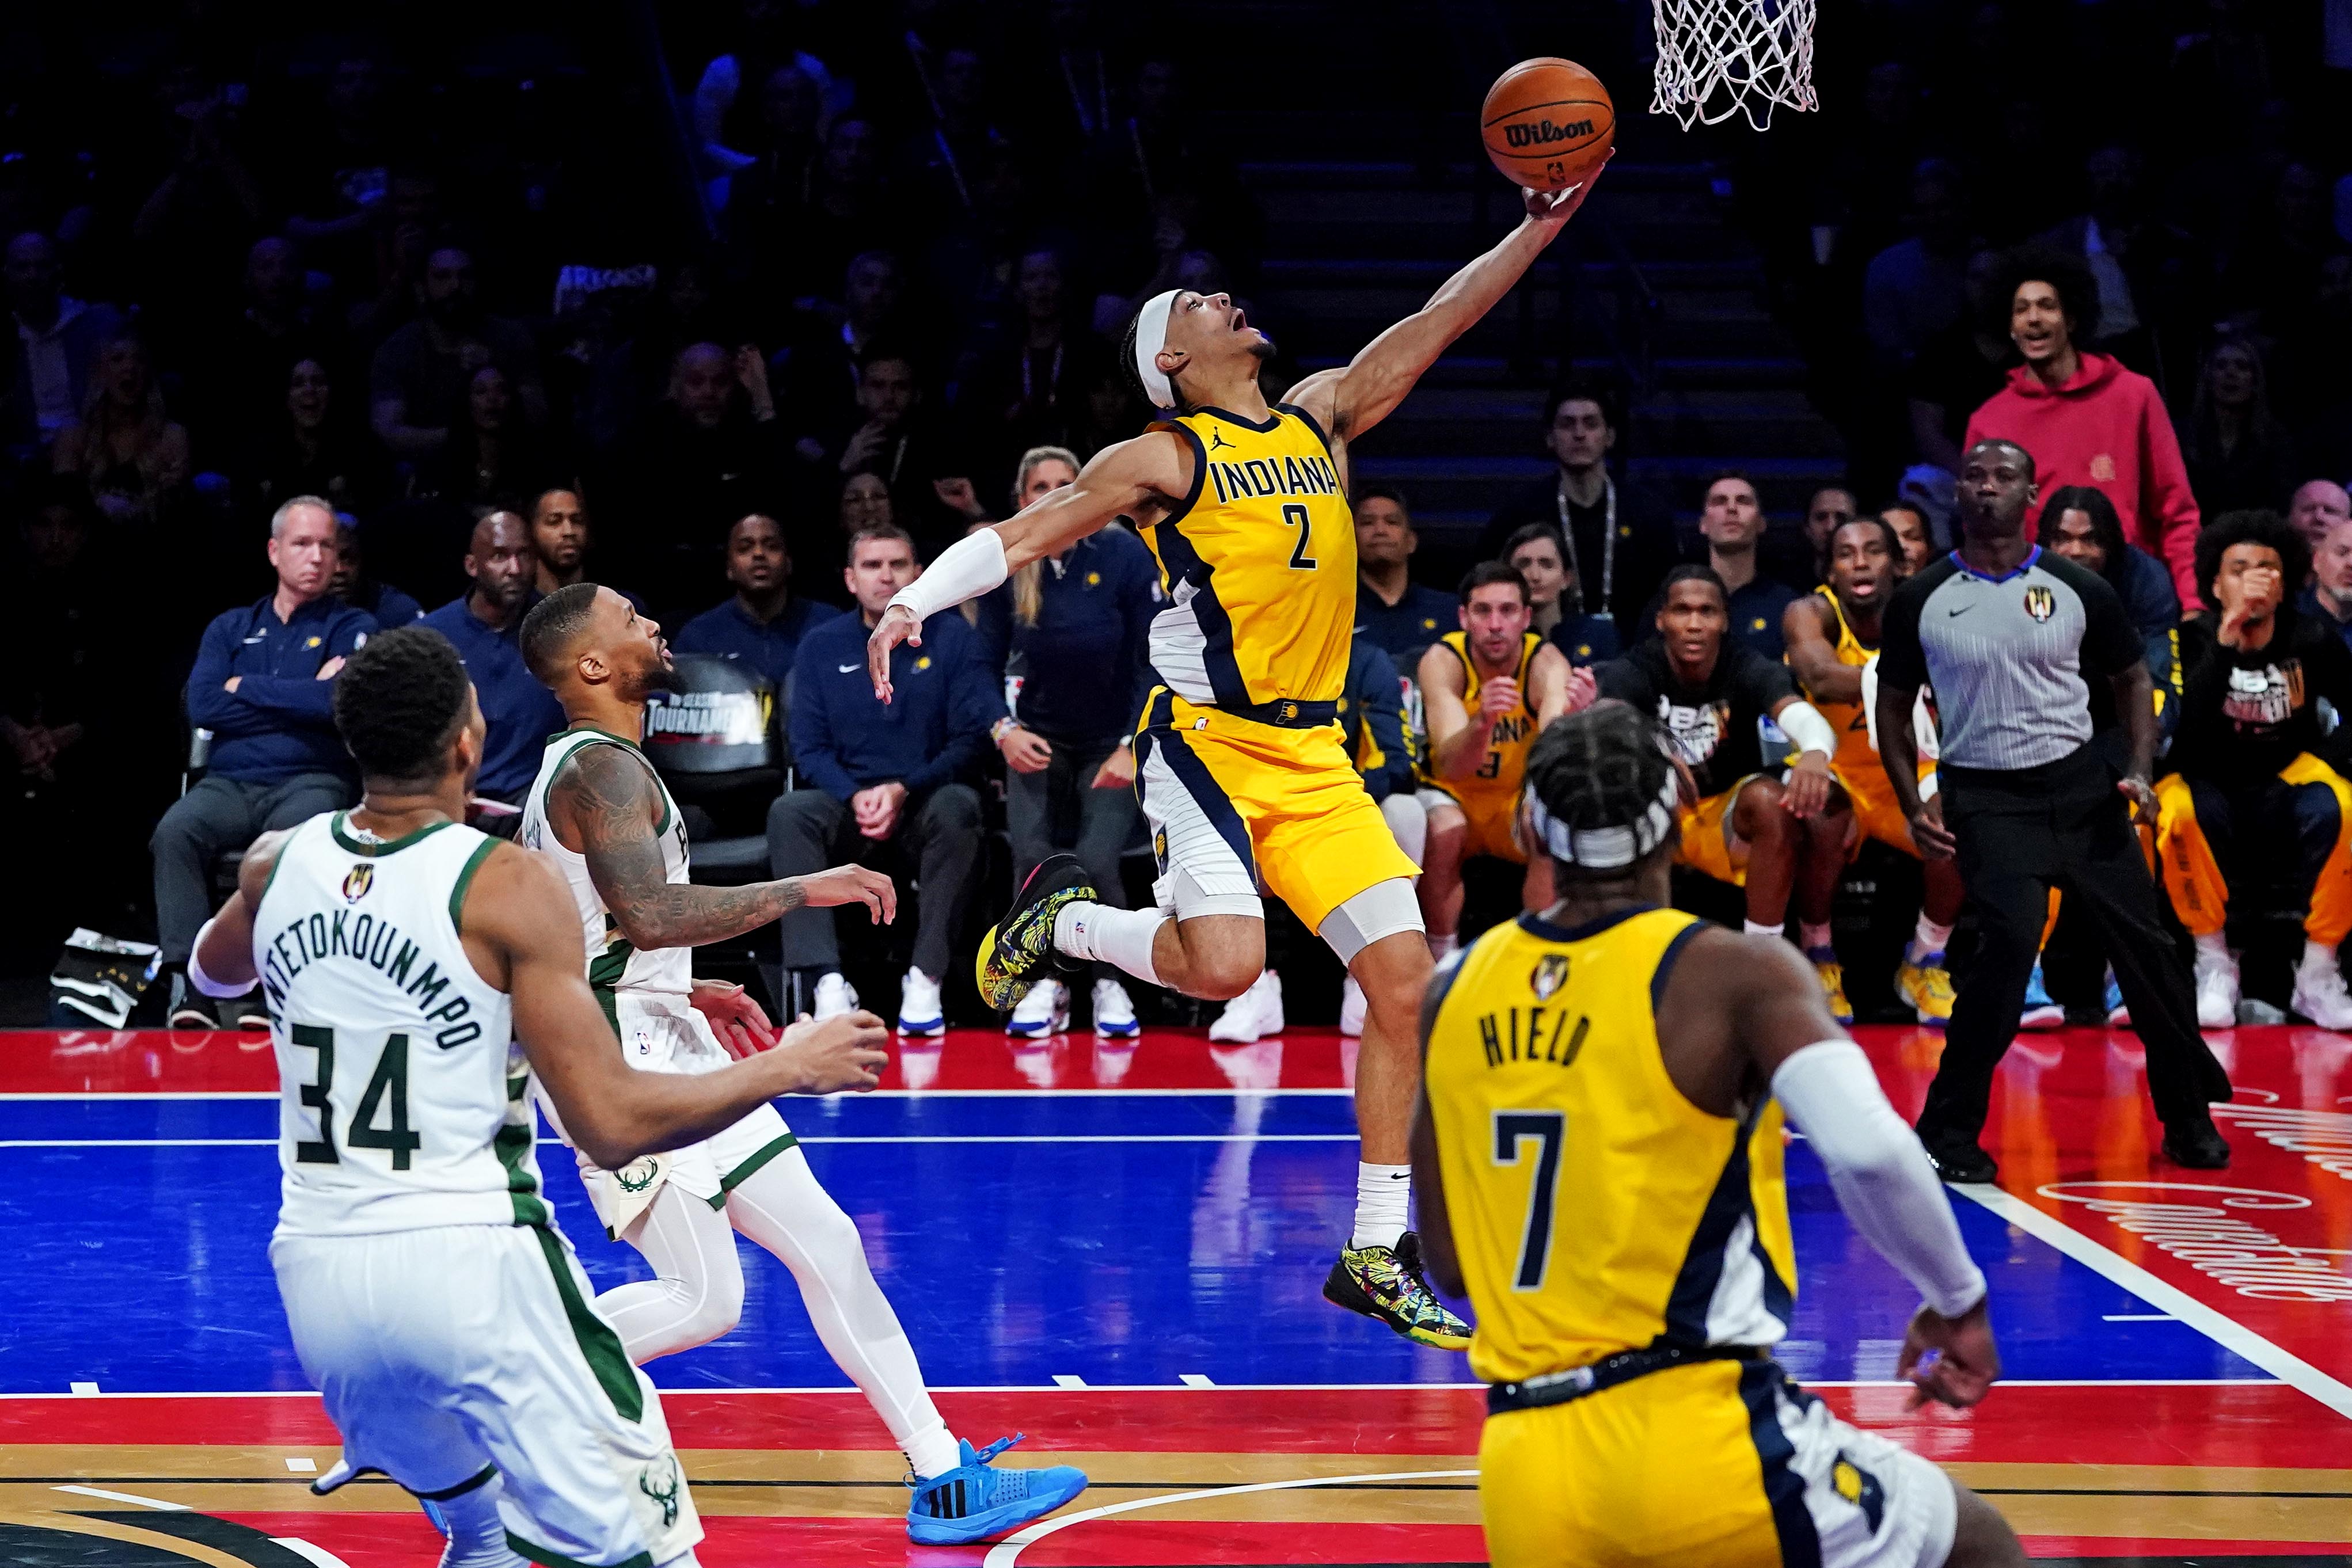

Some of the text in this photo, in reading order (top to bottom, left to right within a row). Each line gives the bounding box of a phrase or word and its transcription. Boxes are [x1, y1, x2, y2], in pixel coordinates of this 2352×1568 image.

[1503, 119, 1595, 147] Wilson
[1207, 456, 1339, 505] INDIANA
[1281, 503, 1317, 570] 2
[647, 699, 763, 744] TOURNAME
[1479, 1007, 1590, 1068] HIELD
[291, 1022, 421, 1171] 34
[1492, 1110, 1566, 1292] 7
